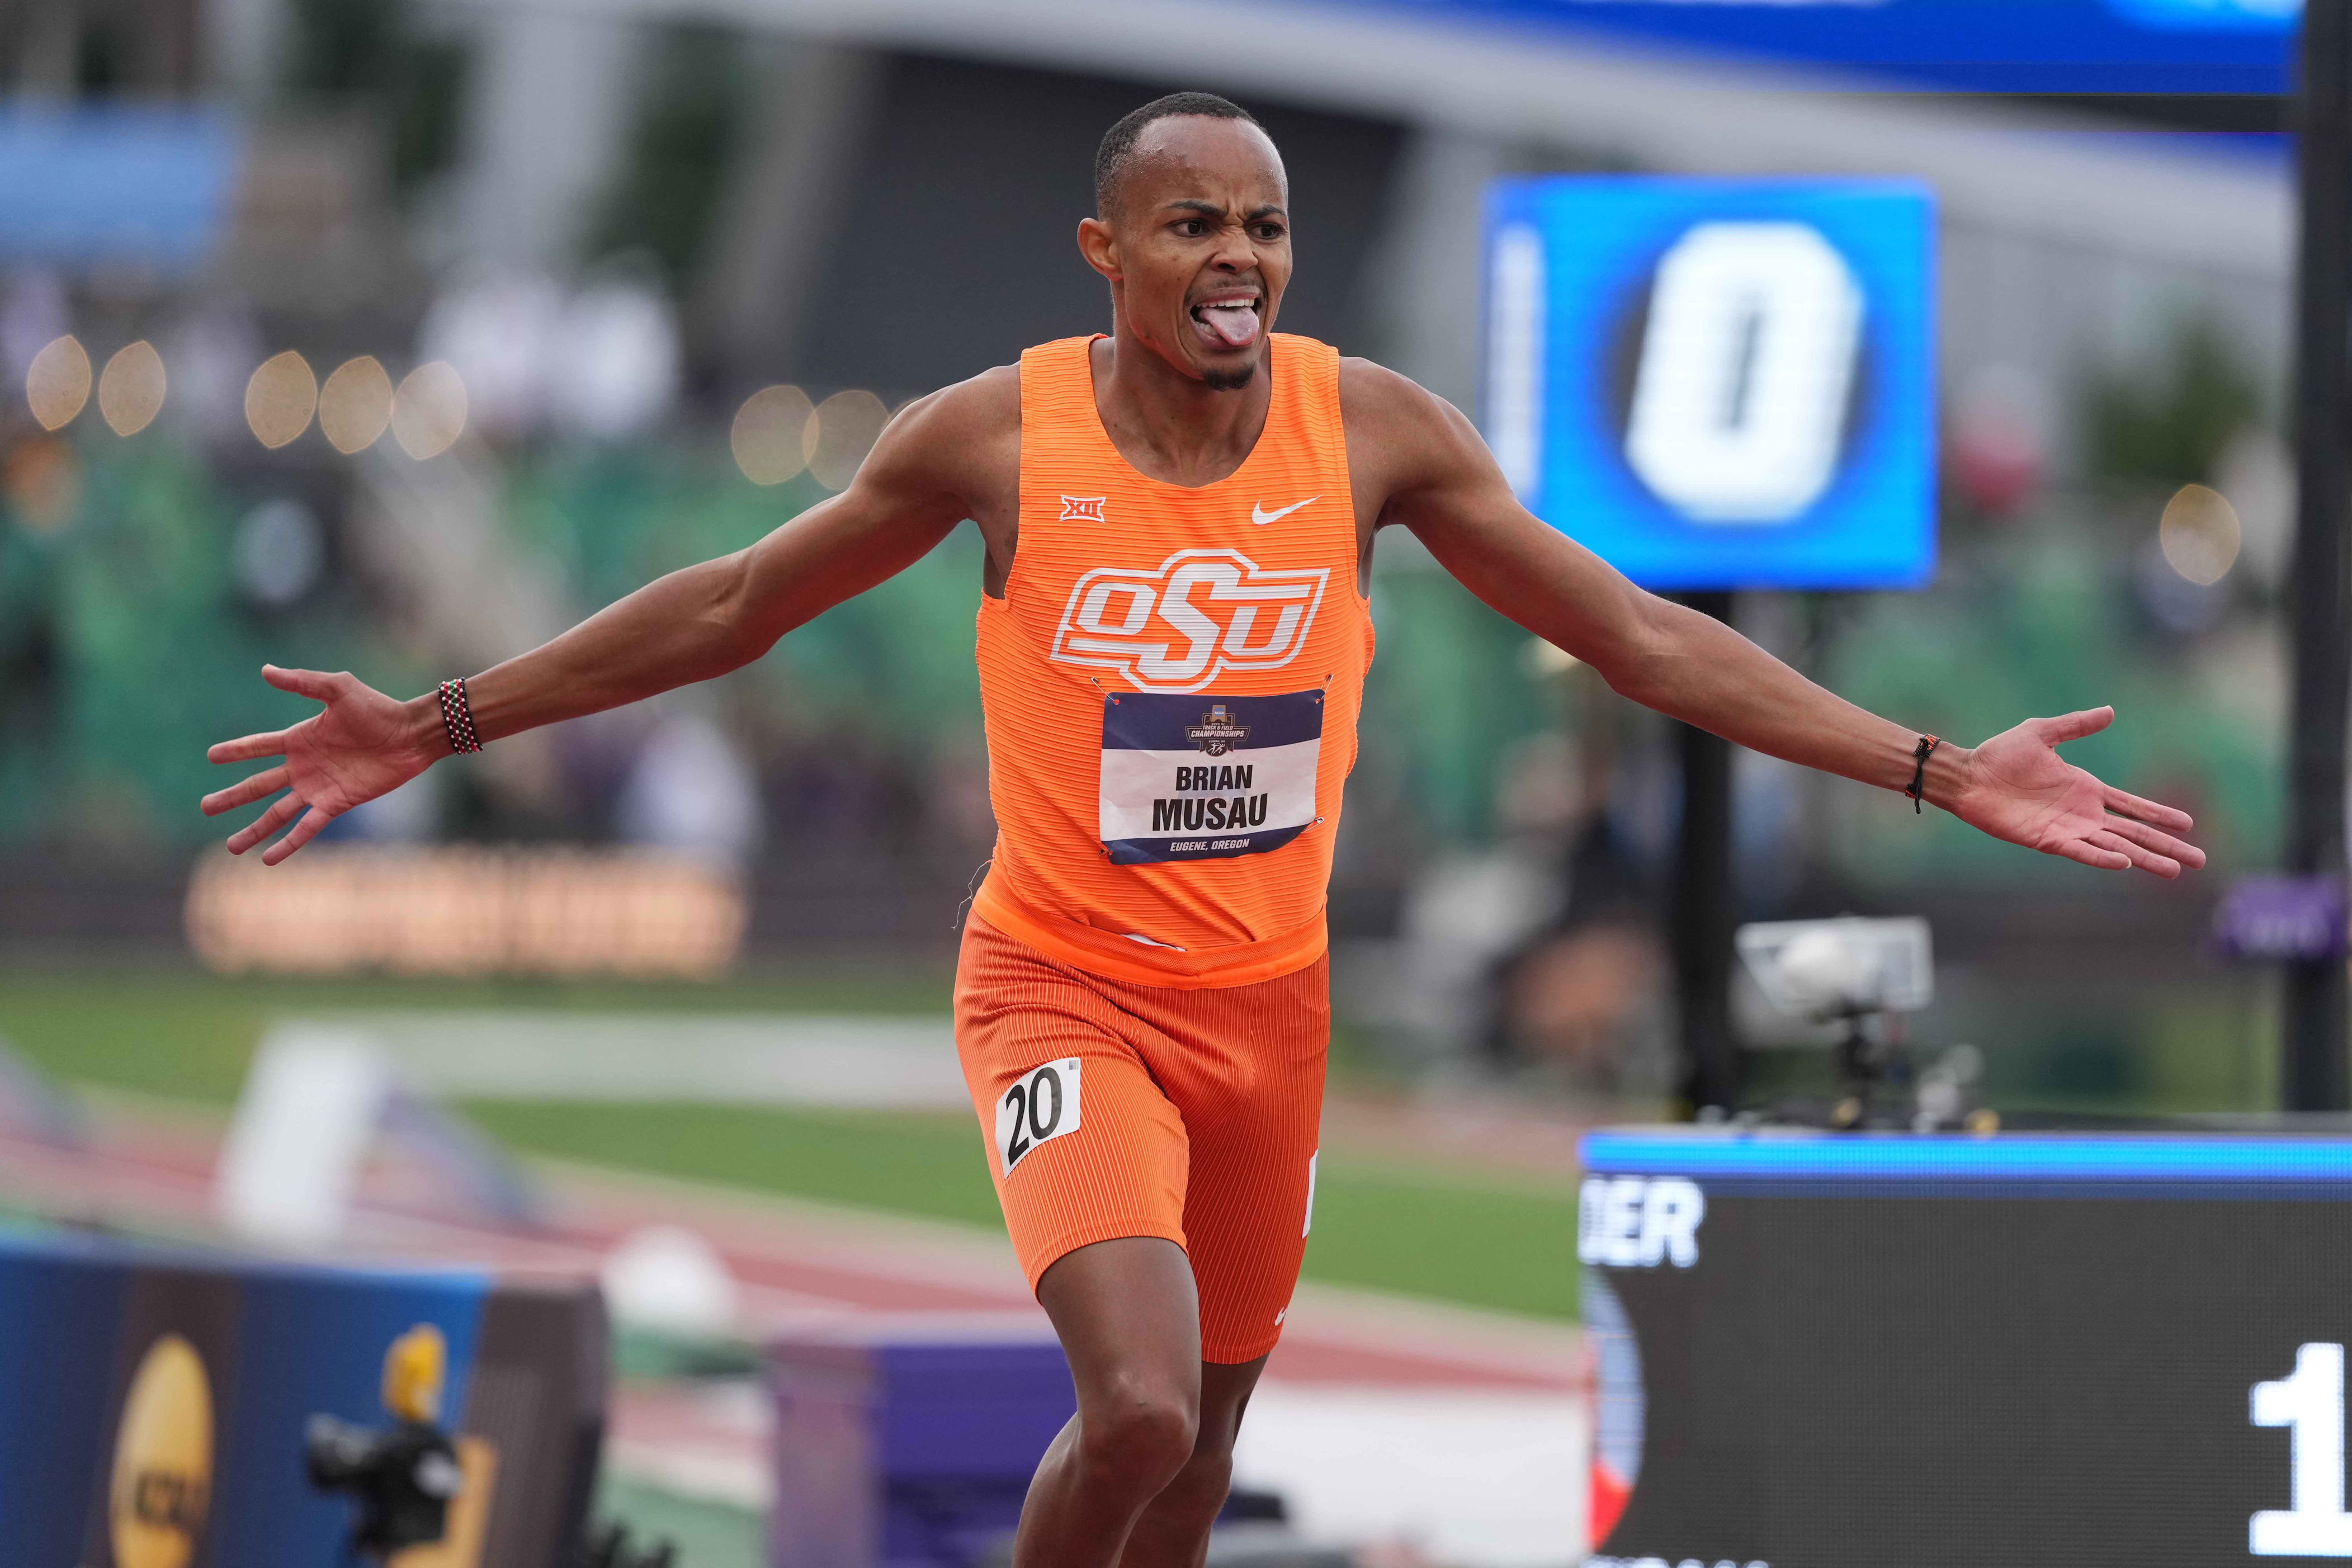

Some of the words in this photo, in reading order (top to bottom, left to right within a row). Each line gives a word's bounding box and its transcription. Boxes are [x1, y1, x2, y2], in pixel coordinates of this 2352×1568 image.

[1624, 221, 1866, 525] 0
[1062, 561, 1314, 681] OSU
[1152, 793, 1268, 831] MUSAU
[1175, 764, 1253, 791] BRIAN
[1170, 841, 1208, 852] EUGENE,
[1211, 839, 1250, 850] OREGON
[1006, 1067, 1062, 1166] 20
[2249, 1342, 2352, 1557] 1
